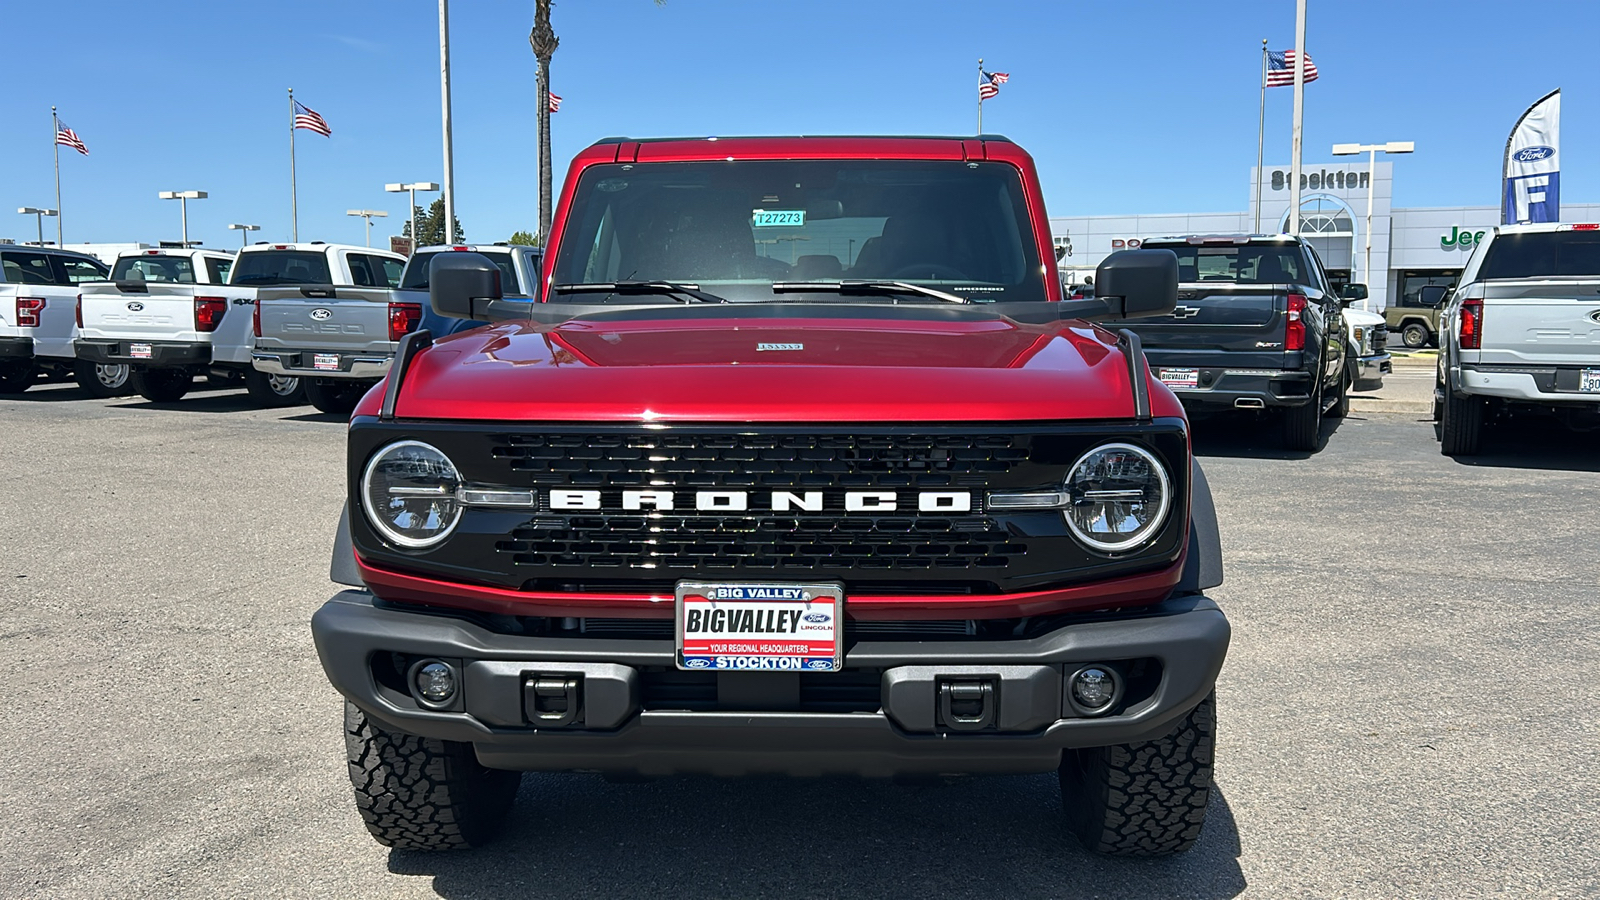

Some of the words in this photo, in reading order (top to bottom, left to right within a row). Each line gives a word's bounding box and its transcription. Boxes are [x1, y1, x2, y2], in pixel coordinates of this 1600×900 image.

[1517, 147, 1551, 162] Ford
[1271, 169, 1370, 190] Stockton
[1515, 175, 1549, 221] F
[757, 213, 801, 223] T27273
[281, 323, 365, 334] F-150
[1161, 372, 1190, 380] BIGVALLEY
[549, 490, 971, 511] BRONCO
[717, 588, 743, 598] BIG
[747, 588, 802, 599] VALLEY
[686, 609, 803, 634] BIGVALLEY
[804, 613, 830, 623] Ford
[710, 644, 728, 653] YOUR
[728, 644, 759, 653] REGIONAL
[759, 644, 809, 654] HEADQUARTERS
[688, 659, 707, 668] Ford
[716, 657, 801, 669] STOCKTON
[810, 660, 829, 669] Ford
